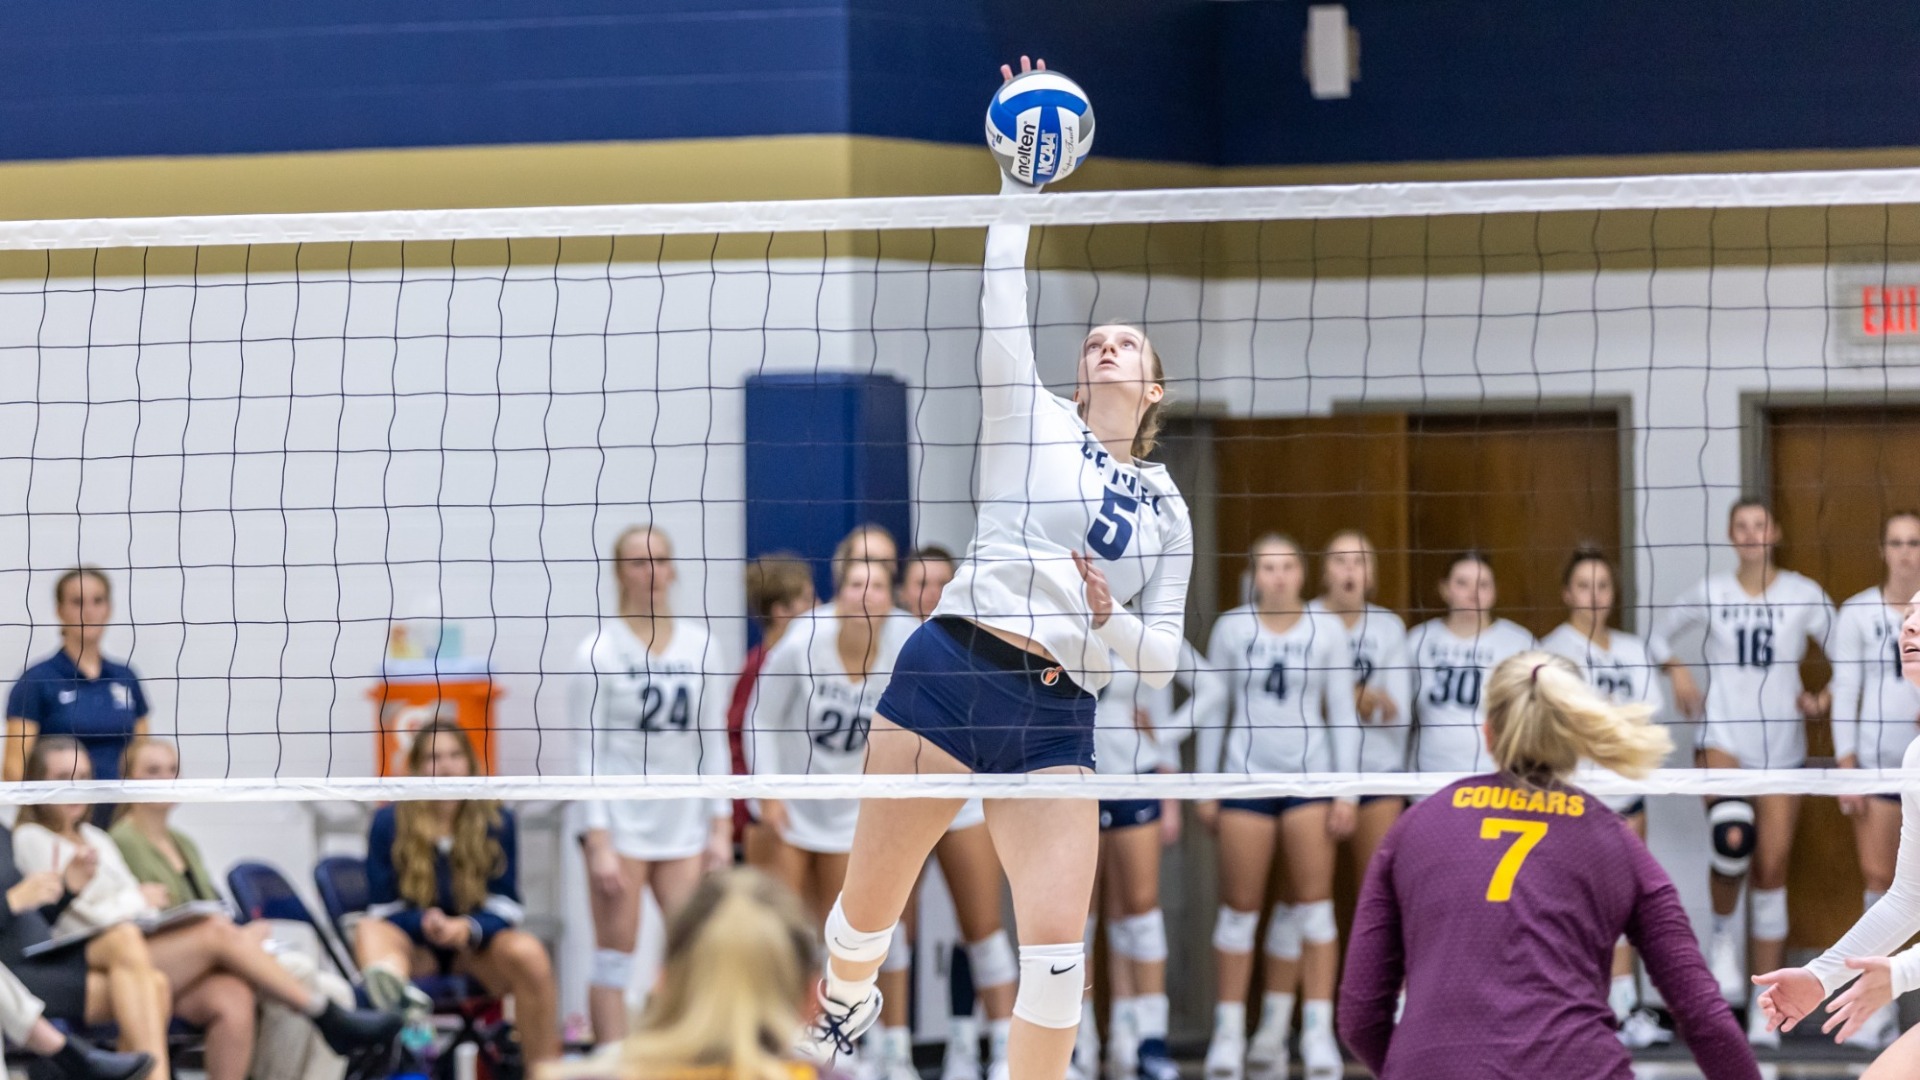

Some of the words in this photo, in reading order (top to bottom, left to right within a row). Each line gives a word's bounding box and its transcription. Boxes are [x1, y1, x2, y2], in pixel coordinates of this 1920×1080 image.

[1018, 123, 1036, 177] molten
[1037, 133, 1057, 175] NCAA
[1087, 485, 1138, 561] 5
[1736, 627, 1773, 668] 16
[1264, 662, 1287, 702] 4
[1429, 665, 1480, 706] 30
[640, 685, 690, 732] 24
[1452, 786, 1585, 817] COUGARS
[1480, 817, 1549, 902] 7
